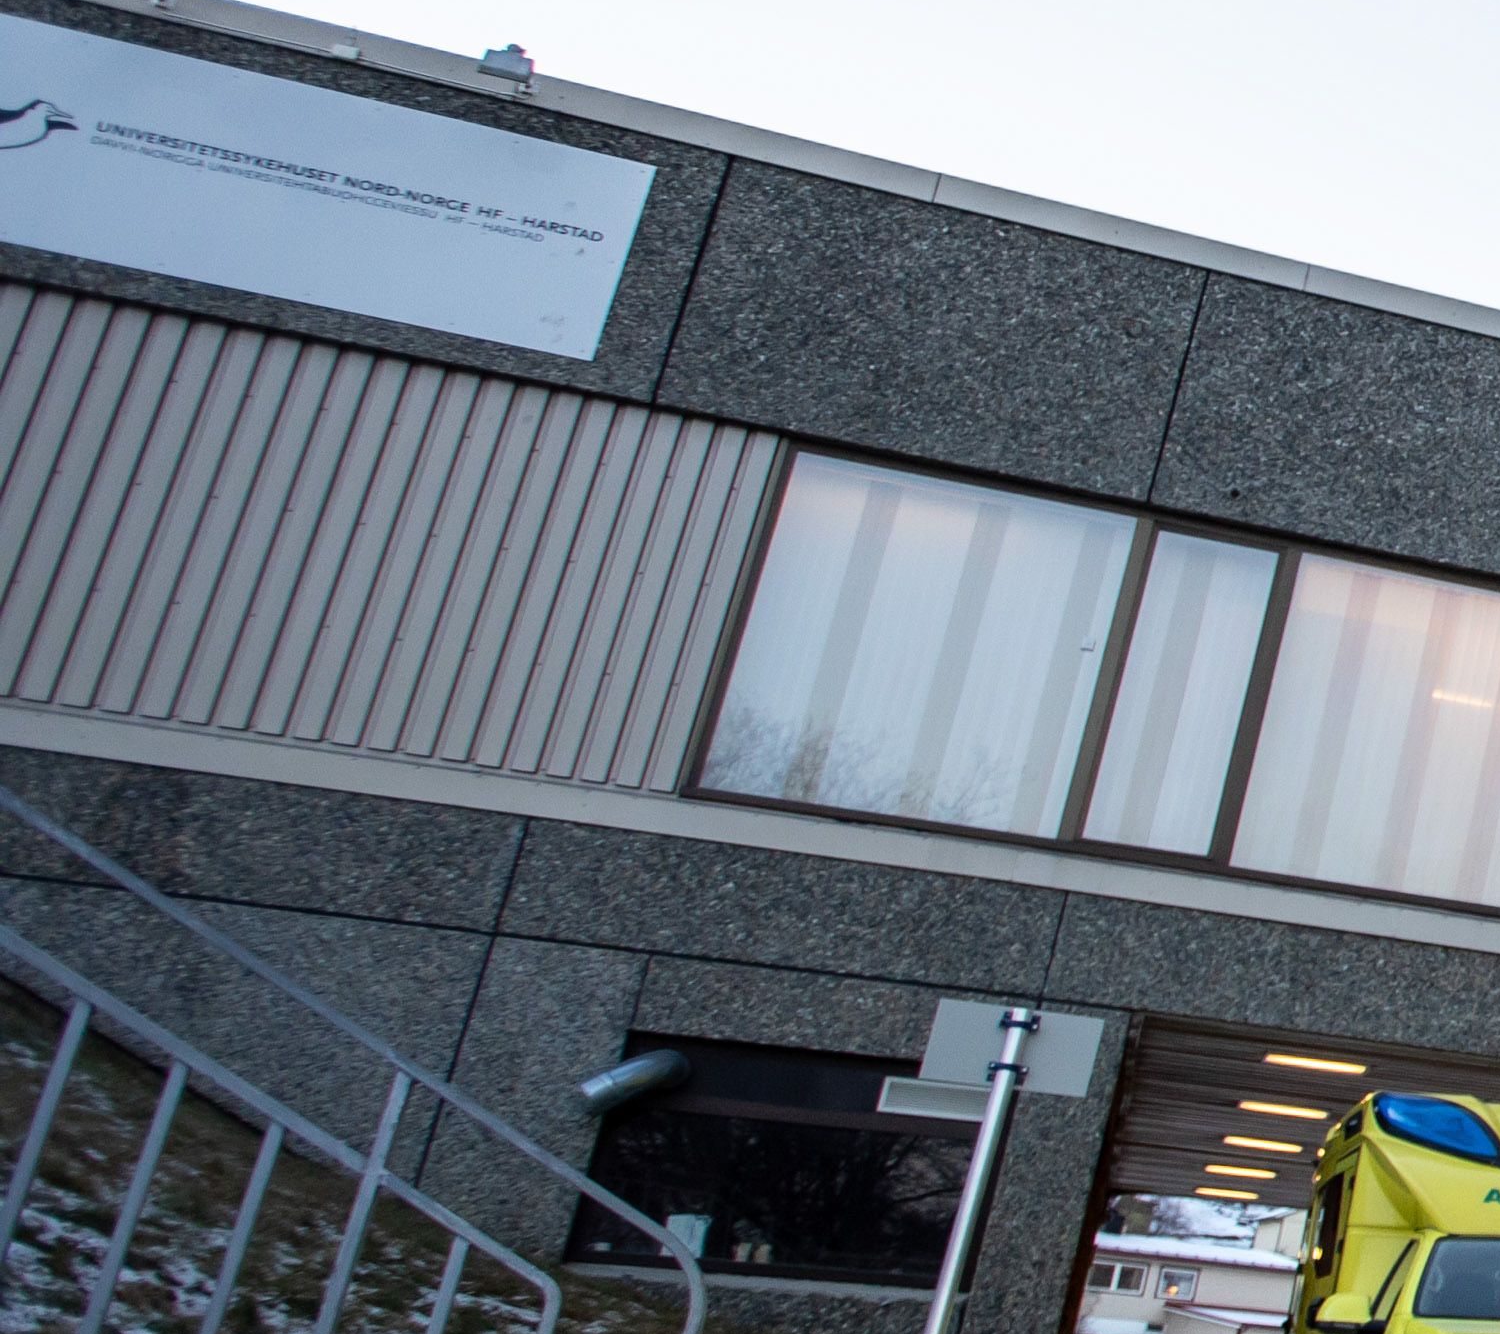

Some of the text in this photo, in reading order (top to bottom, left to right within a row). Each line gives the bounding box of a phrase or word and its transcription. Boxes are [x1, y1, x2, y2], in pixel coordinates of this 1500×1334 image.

[96, 121, 340, 183] UNIVERSITETSSYKEHUSET
[343, 176, 471, 213] NORD-NORGE
[476, 205, 503, 220] HF
[520, 215, 605, 243] HARSTAD
[480, 221, 546, 244] HARSTAD
